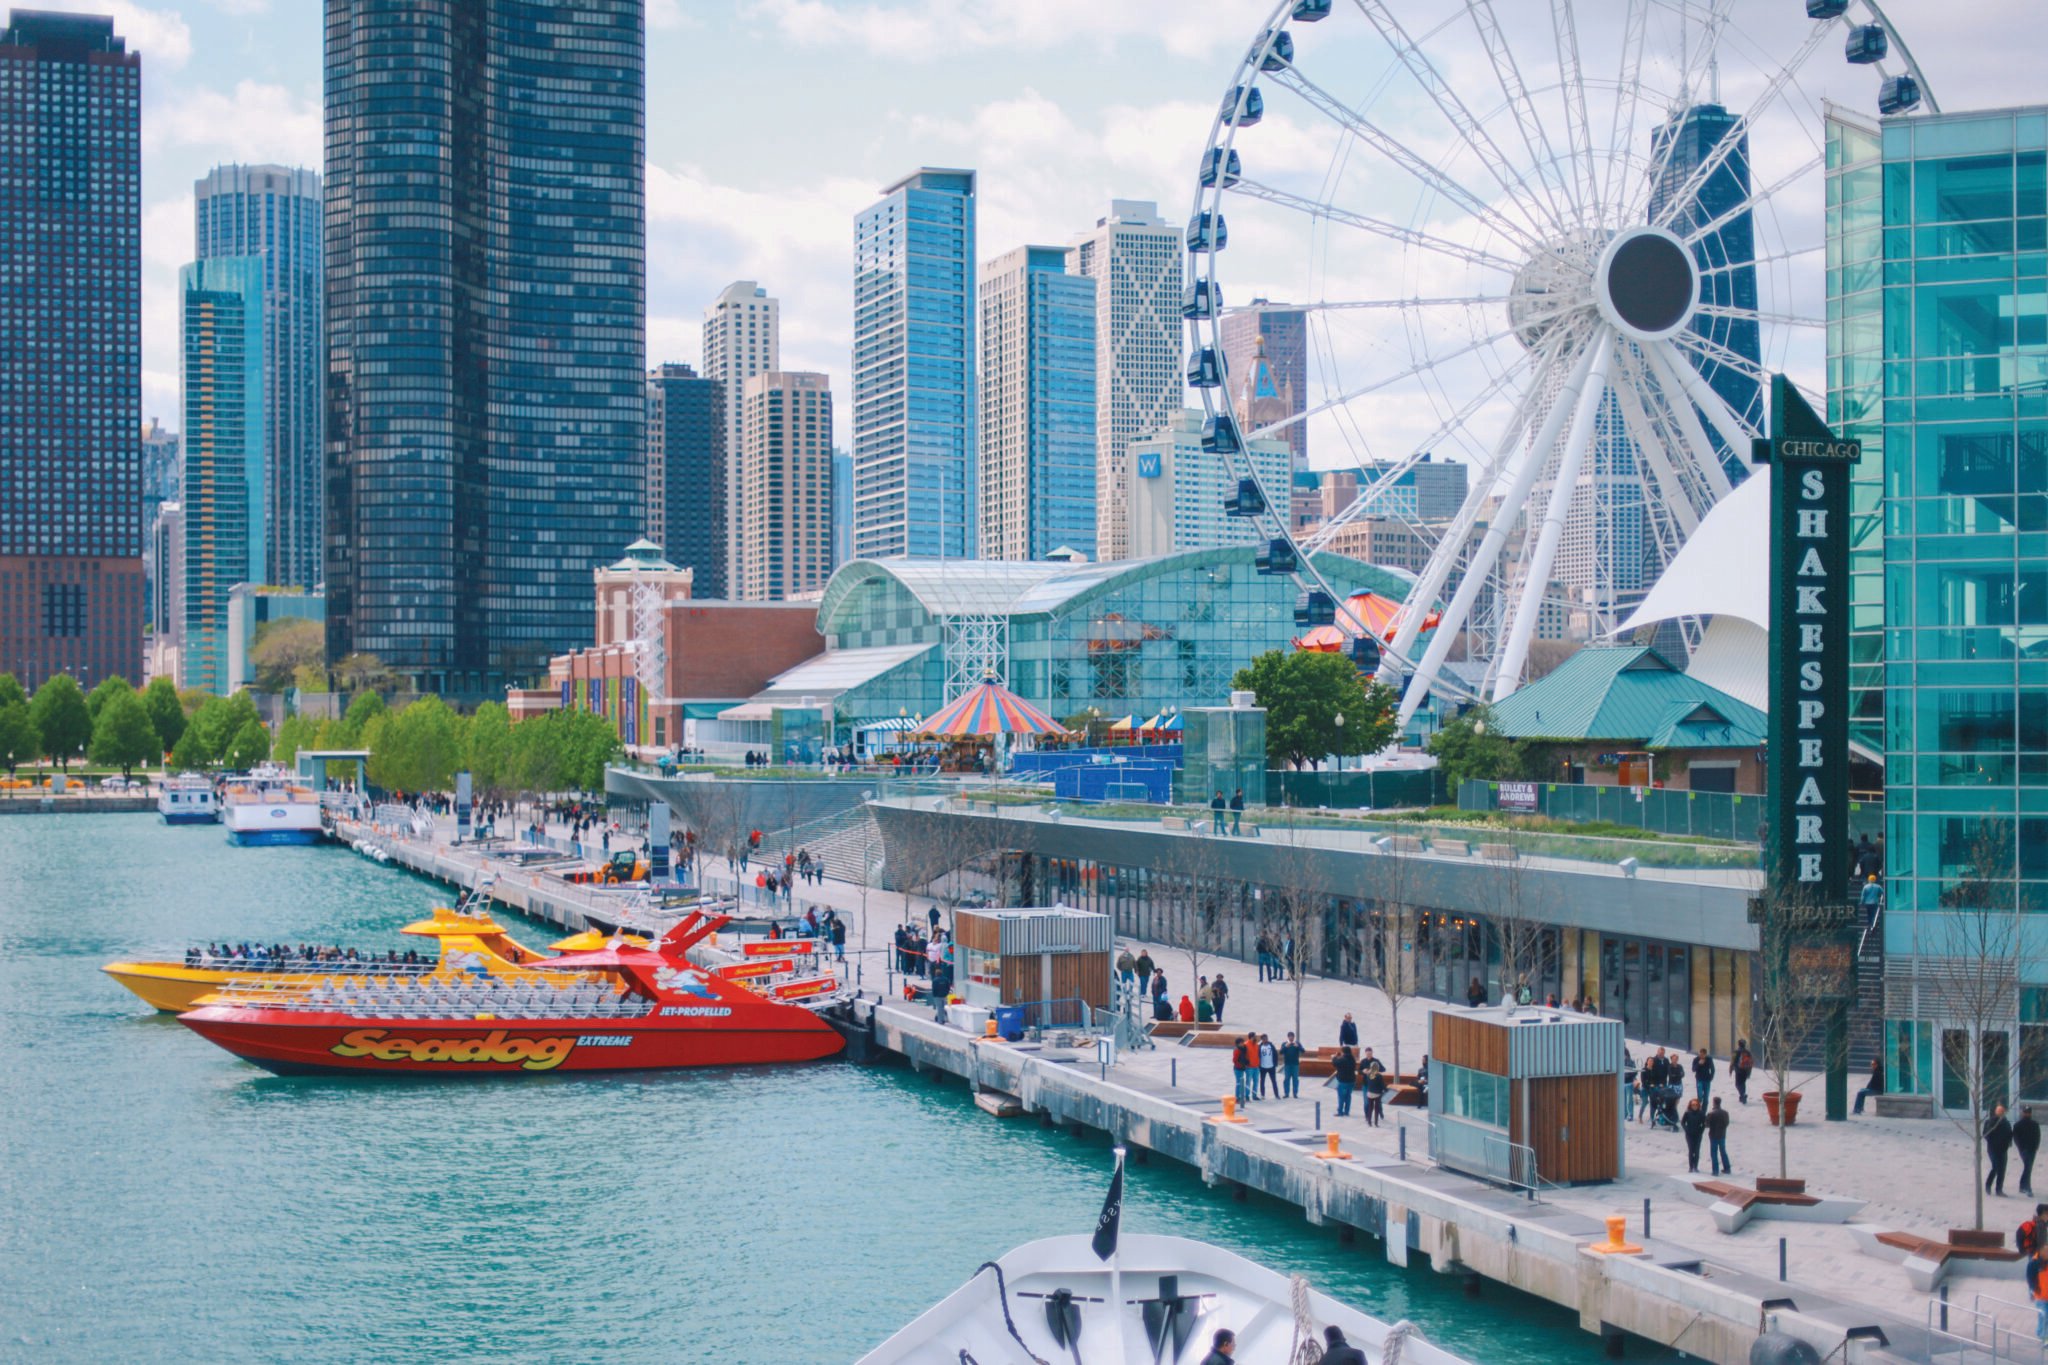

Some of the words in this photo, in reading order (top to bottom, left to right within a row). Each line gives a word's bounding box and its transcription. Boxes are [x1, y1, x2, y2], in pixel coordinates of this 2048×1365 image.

[1781, 441, 1860, 458] CHICAGO
[1140, 456, 1157, 473] W
[1795, 470, 1828, 882] SHAKESPEARE
[1779, 905, 1856, 920] THEATER
[659, 1006, 732, 1017] JET-PROPELLED
[330, 1028, 577, 1071] Seadog
[576, 1035, 633, 1047] EXTREME
